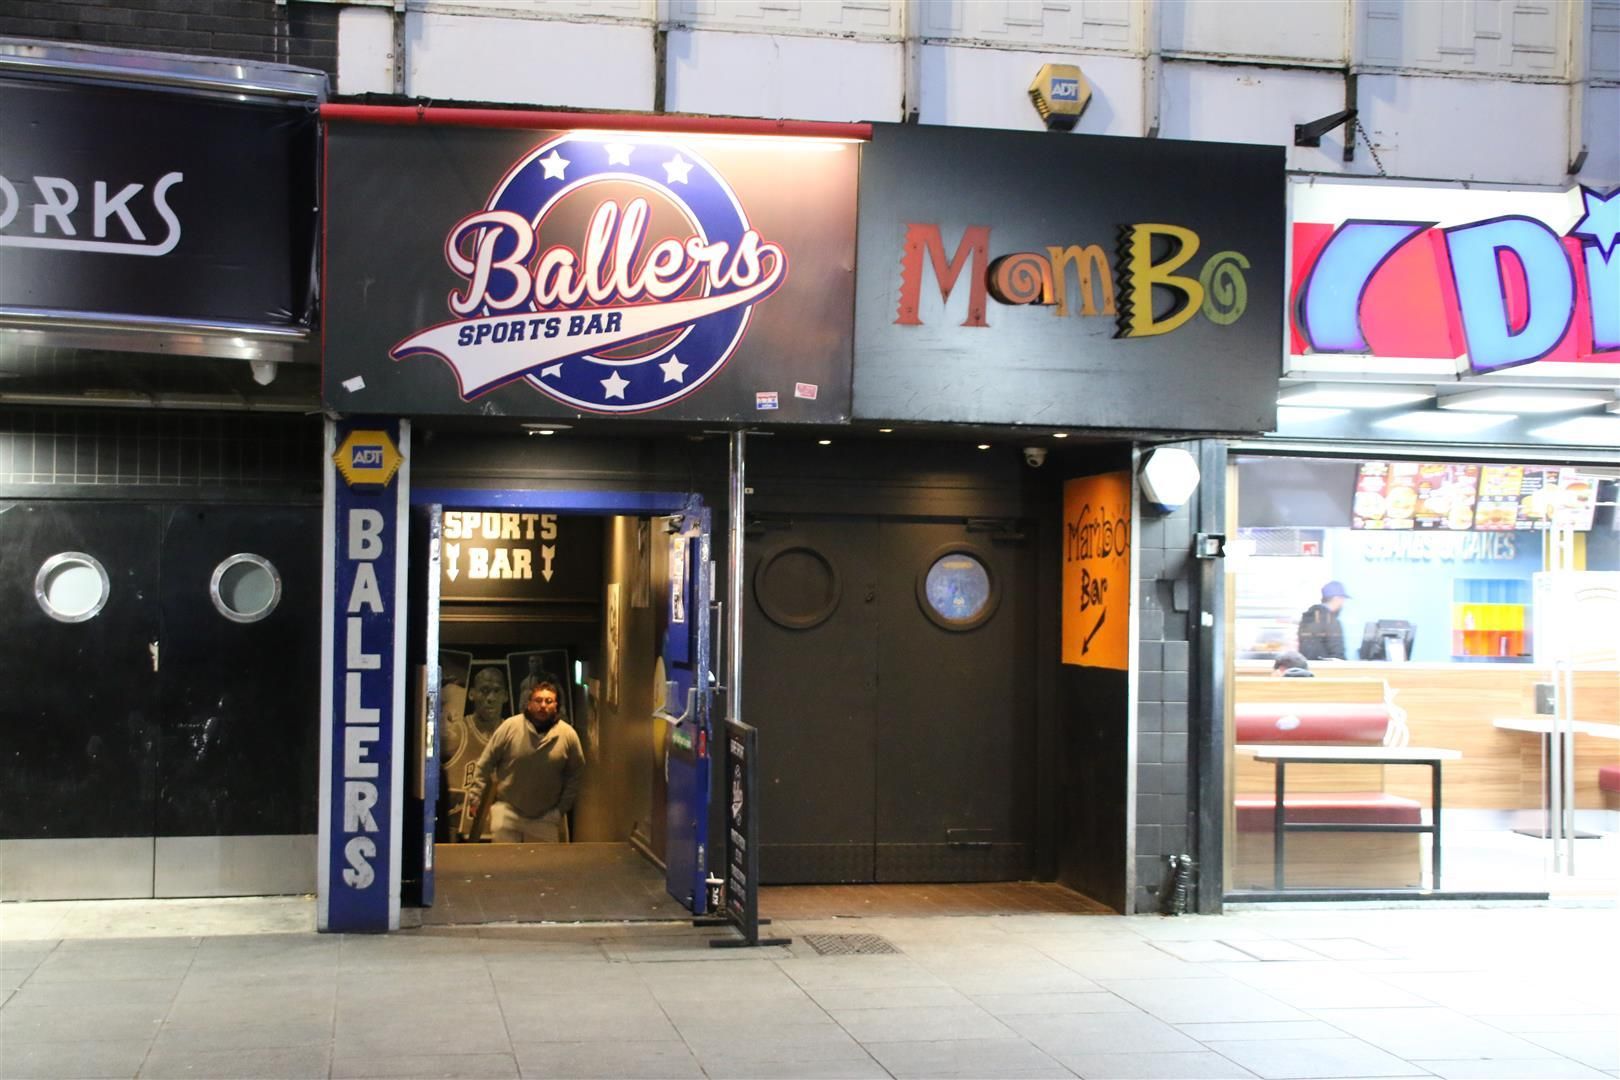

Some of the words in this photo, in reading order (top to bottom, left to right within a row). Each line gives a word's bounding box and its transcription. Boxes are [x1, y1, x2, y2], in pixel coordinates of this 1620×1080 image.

[1051, 82, 1078, 97] ADT
[446, 197, 768, 315] Ballers
[457, 317, 562, 347] SPORTS
[567, 311, 623, 337] BAR
[352, 449, 384, 464] ADT
[444, 511, 558, 540] SPORTS
[468, 547, 532, 579] BAR
[1080, 567, 1108, 612] Bar
[342, 507, 384, 890] BALLERS
